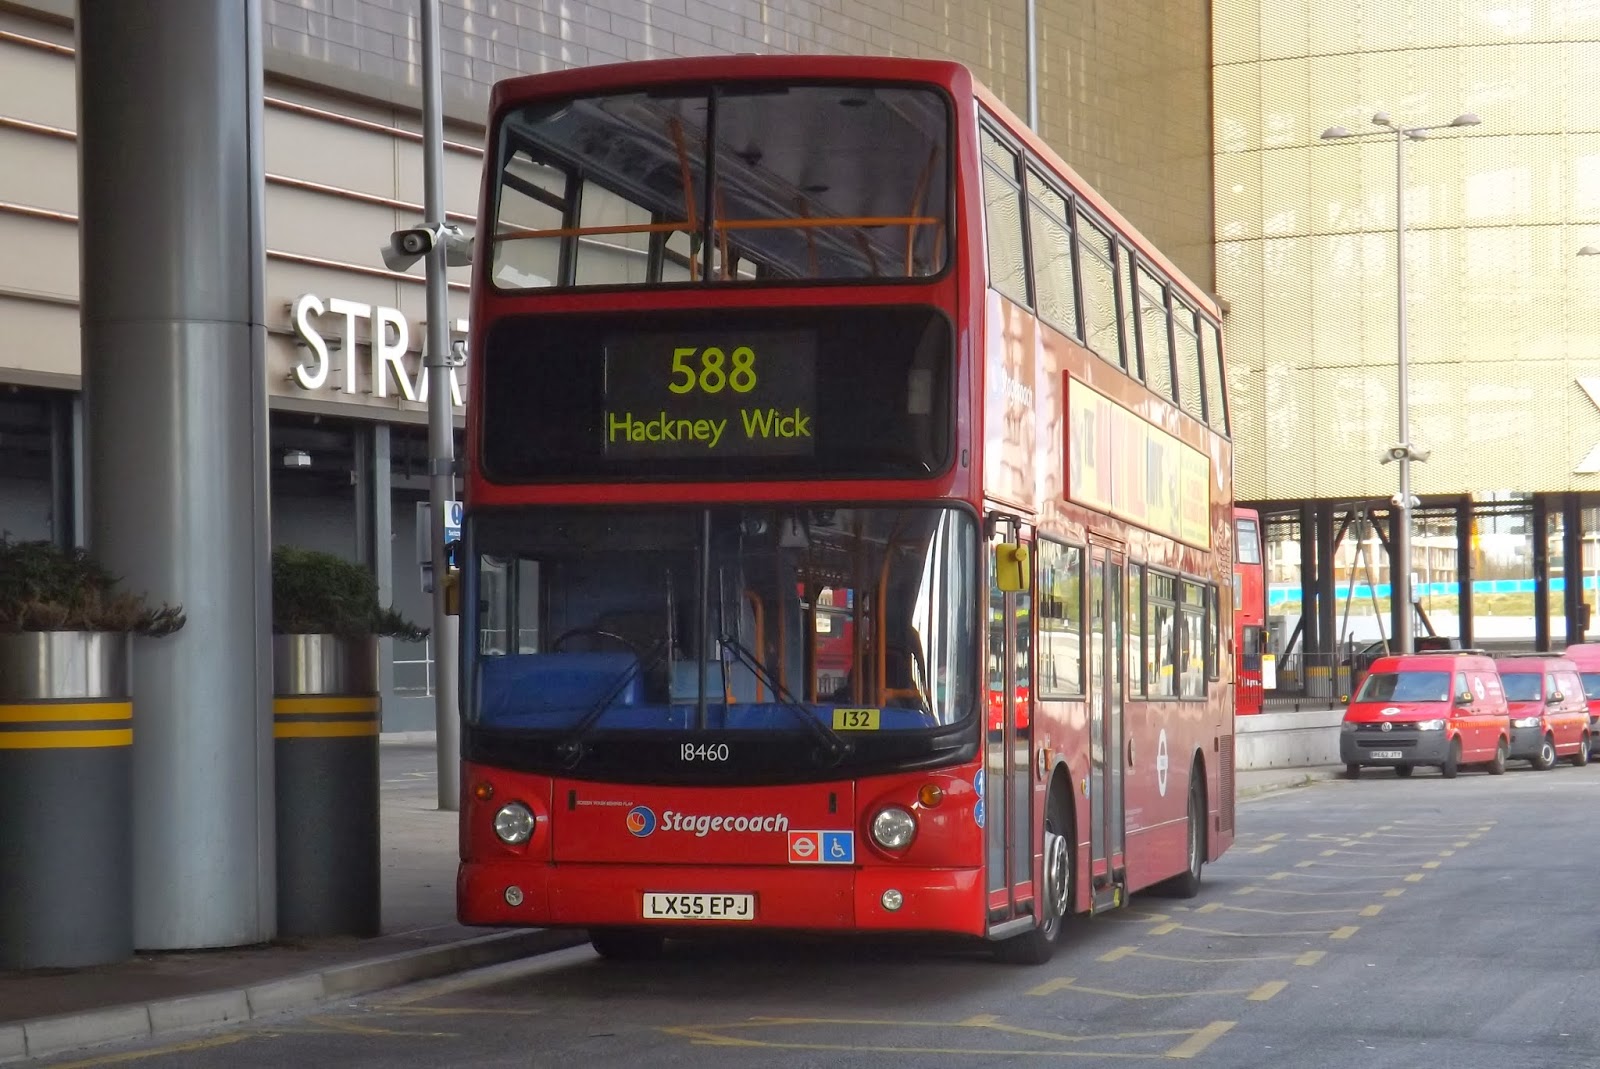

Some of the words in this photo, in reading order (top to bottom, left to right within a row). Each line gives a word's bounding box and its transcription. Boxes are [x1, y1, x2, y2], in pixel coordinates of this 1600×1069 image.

[291, 294, 468, 406] STR
[668, 347, 757, 394] 588
[609, 411, 727, 448] Hackney
[741, 408, 811, 438] Wick
[843, 711, 870, 727] 132
[680, 743, 729, 761] 18460
[660, 810, 789, 837] Stagecoach
[652, 896, 704, 915] LX55
[710, 897, 748, 915] EPJ
